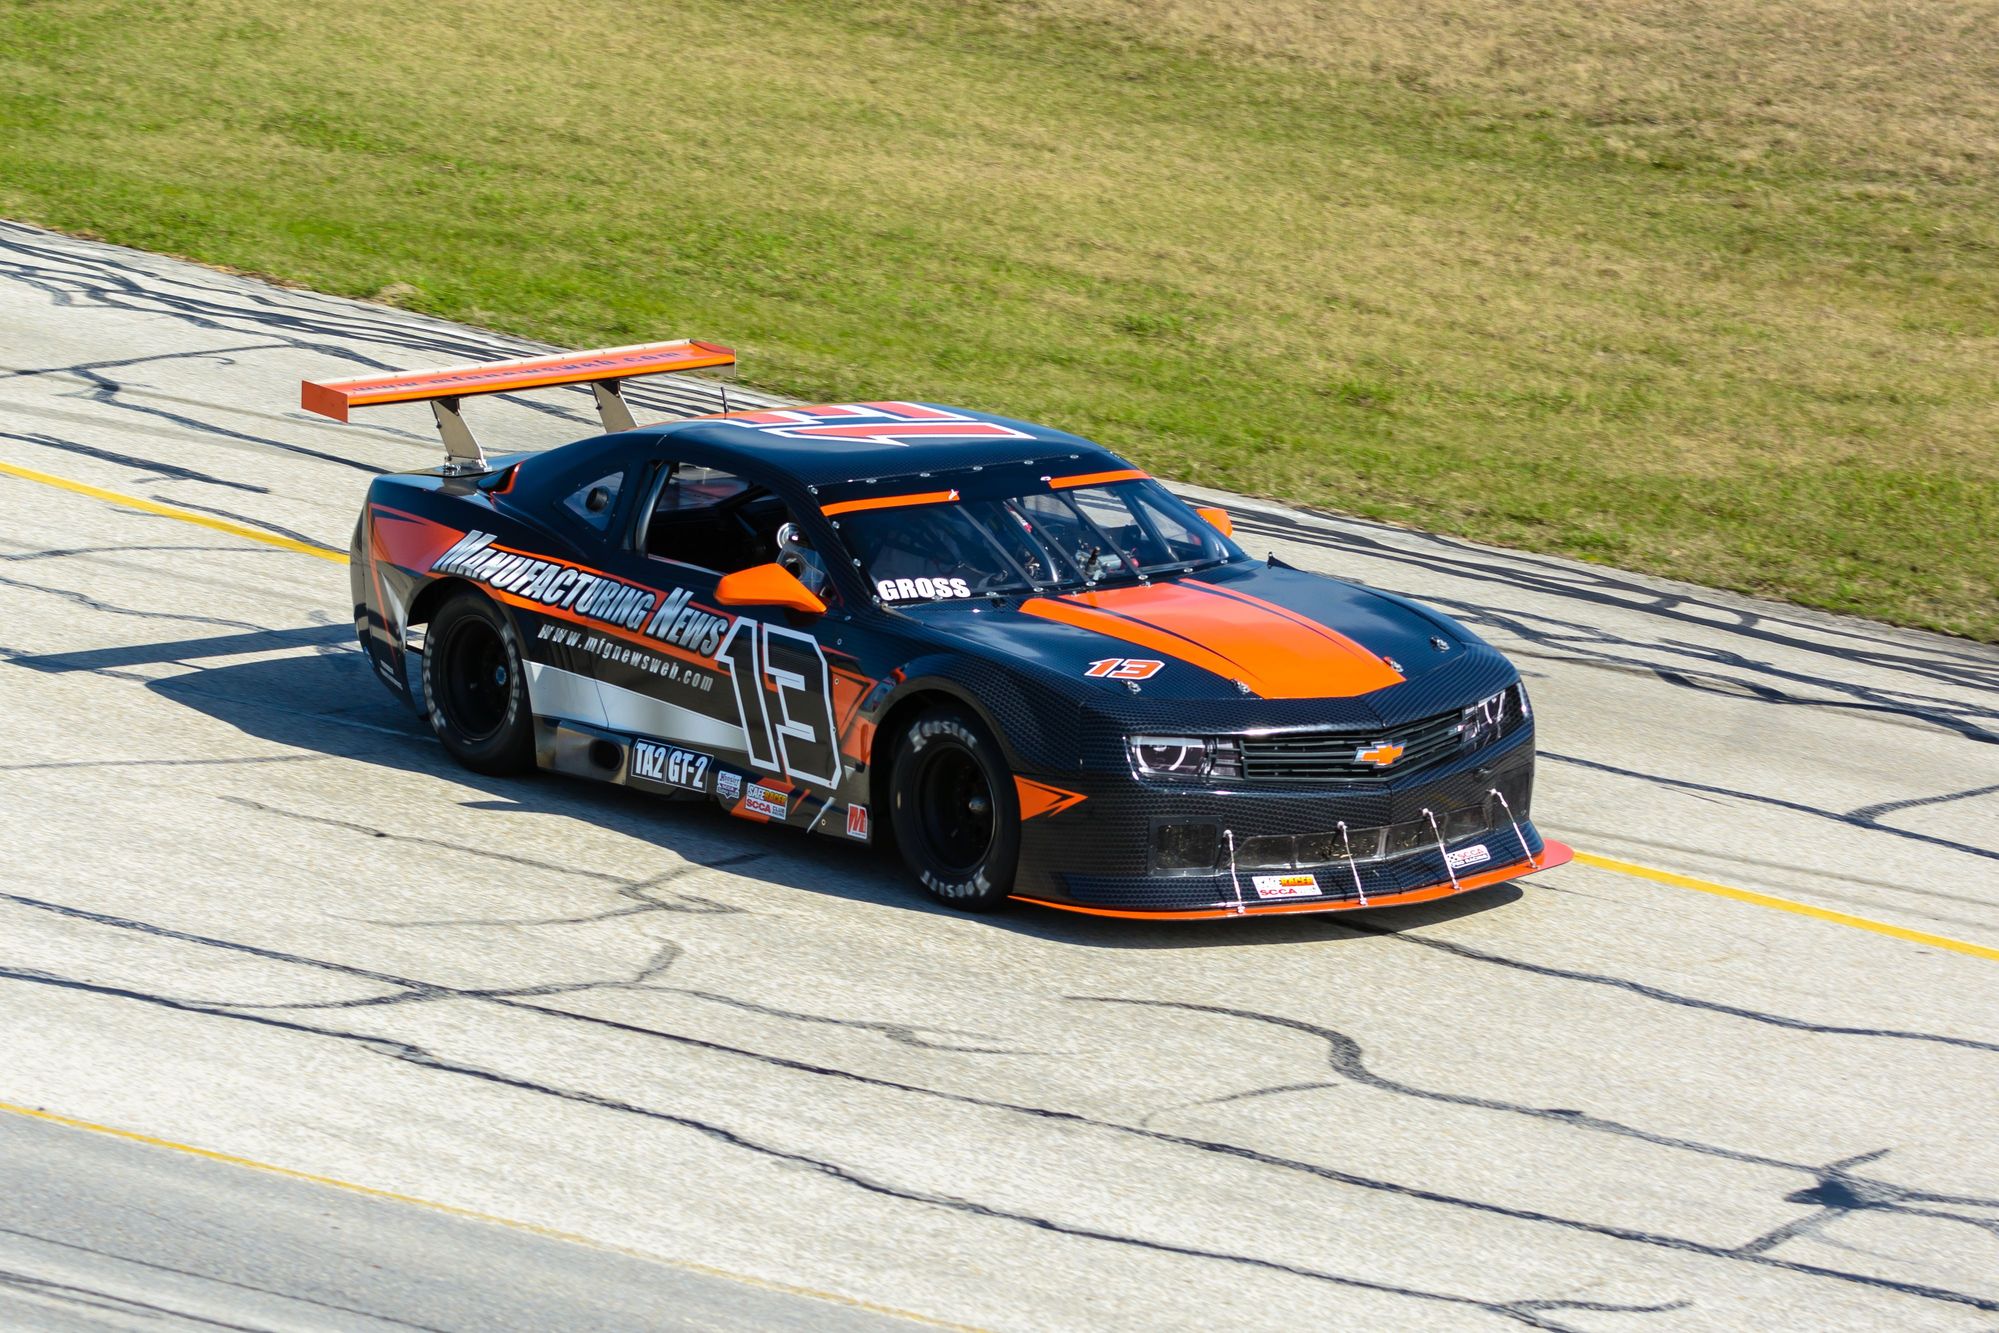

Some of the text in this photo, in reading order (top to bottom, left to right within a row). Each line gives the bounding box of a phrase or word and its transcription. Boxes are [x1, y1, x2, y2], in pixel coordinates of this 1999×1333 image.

[877, 577, 971, 600] GROSS
[536, 623, 715, 693] www.mfgnewsweb.com
[1084, 657, 1165, 680] 13
[715, 616, 842, 790] 13
[635, 742, 708, 789] TA2 GT-2
[746, 799, 771, 814] SCCA
[1260, 888, 1297, 896] SCCA
